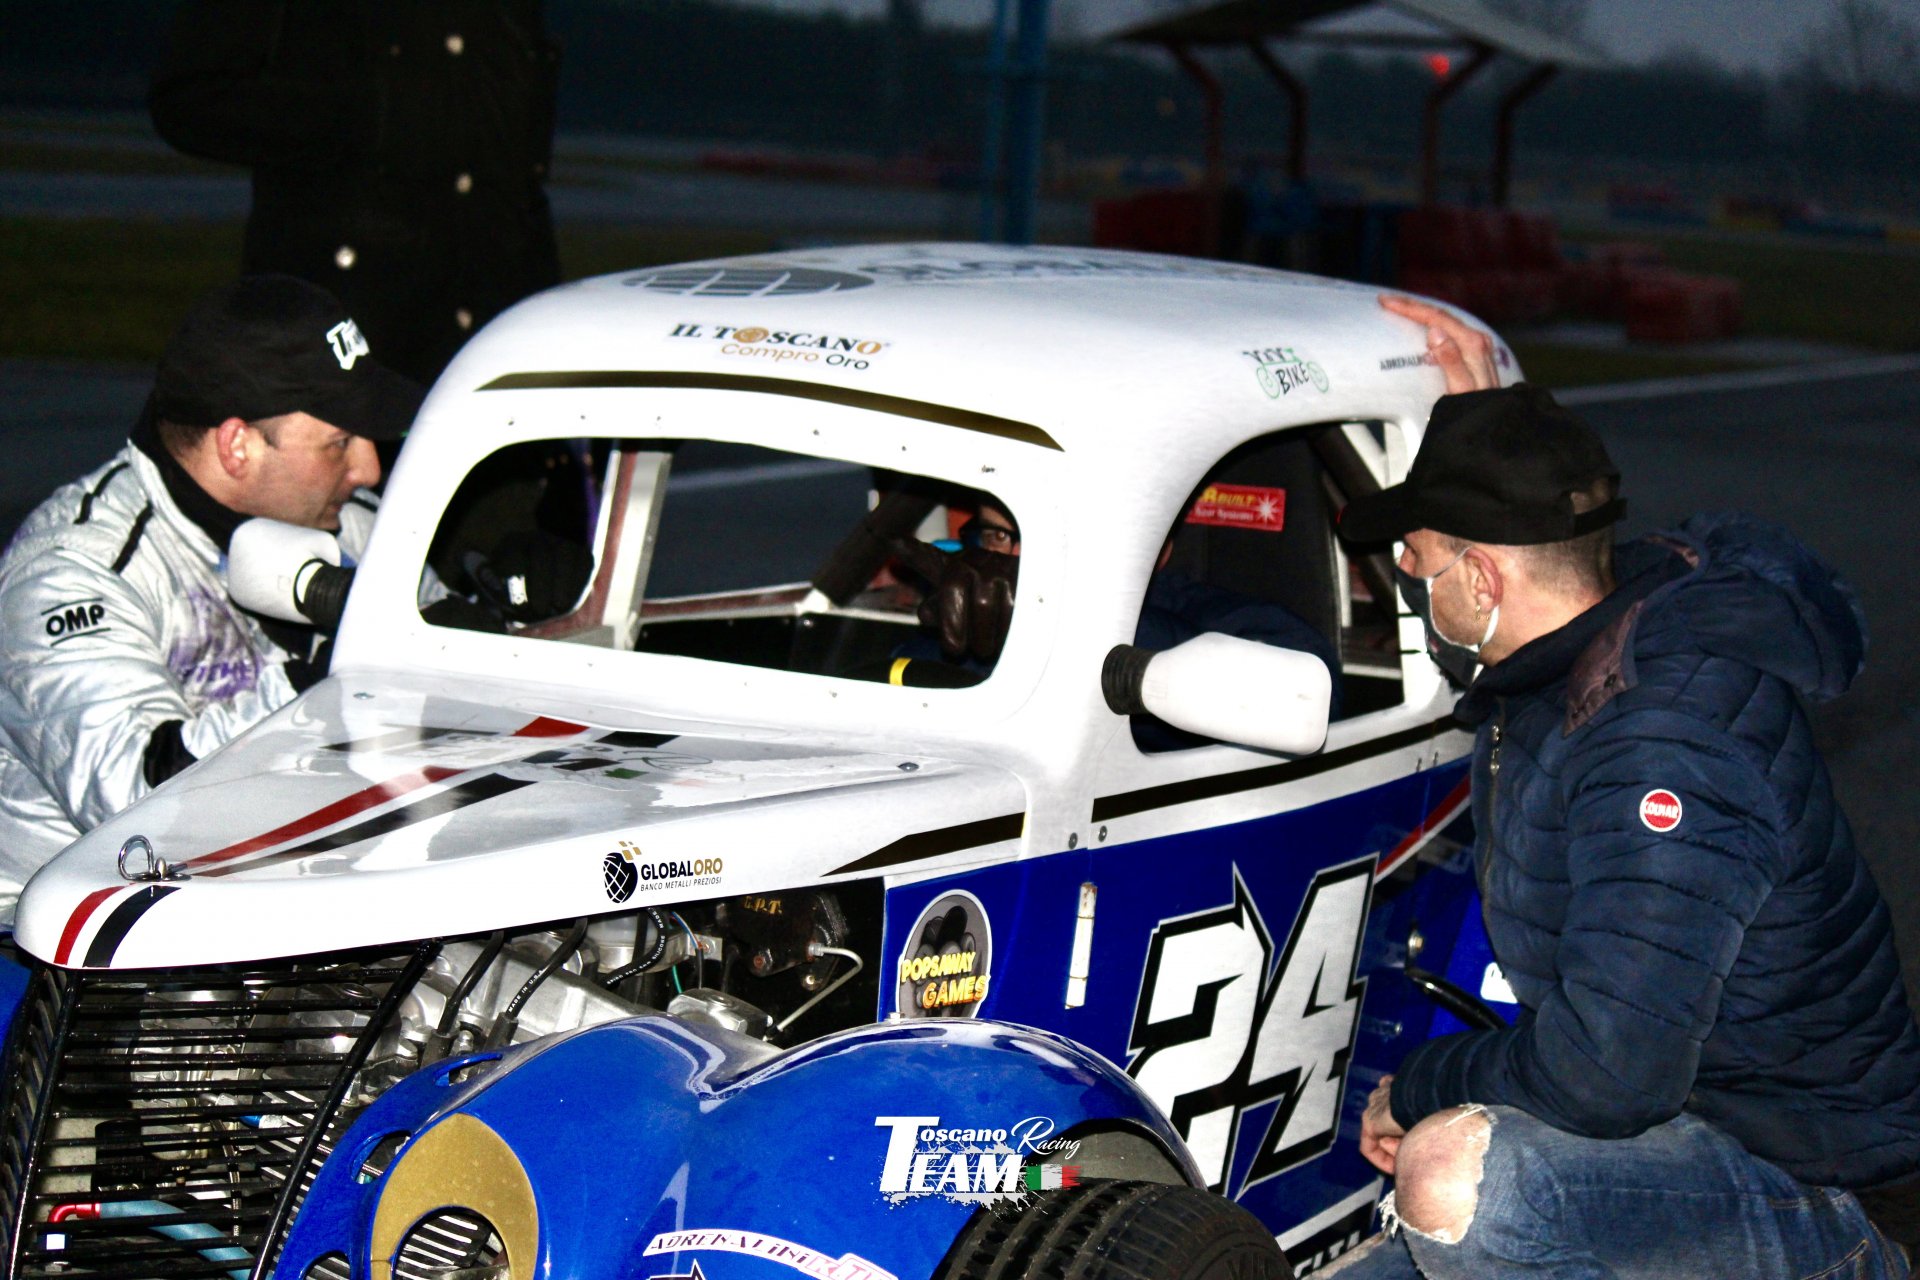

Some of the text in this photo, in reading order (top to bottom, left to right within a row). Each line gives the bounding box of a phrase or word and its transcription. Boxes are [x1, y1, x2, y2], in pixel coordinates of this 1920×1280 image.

[668, 322, 702, 338] IL
[720, 343, 869, 371] Compro Oro
[1275, 361, 1310, 395] BIKE
[46, 604, 105, 636] OMP
[640, 858, 723, 881] GLOBALORO
[640, 876, 722, 892] BANCO METALLI PREZIOSI
[901, 951, 976, 982] POPSAWAY
[508, 994, 521, 1013] MADE
[922, 975, 988, 1009] GAMES
[1128, 856, 1376, 1196] 24
